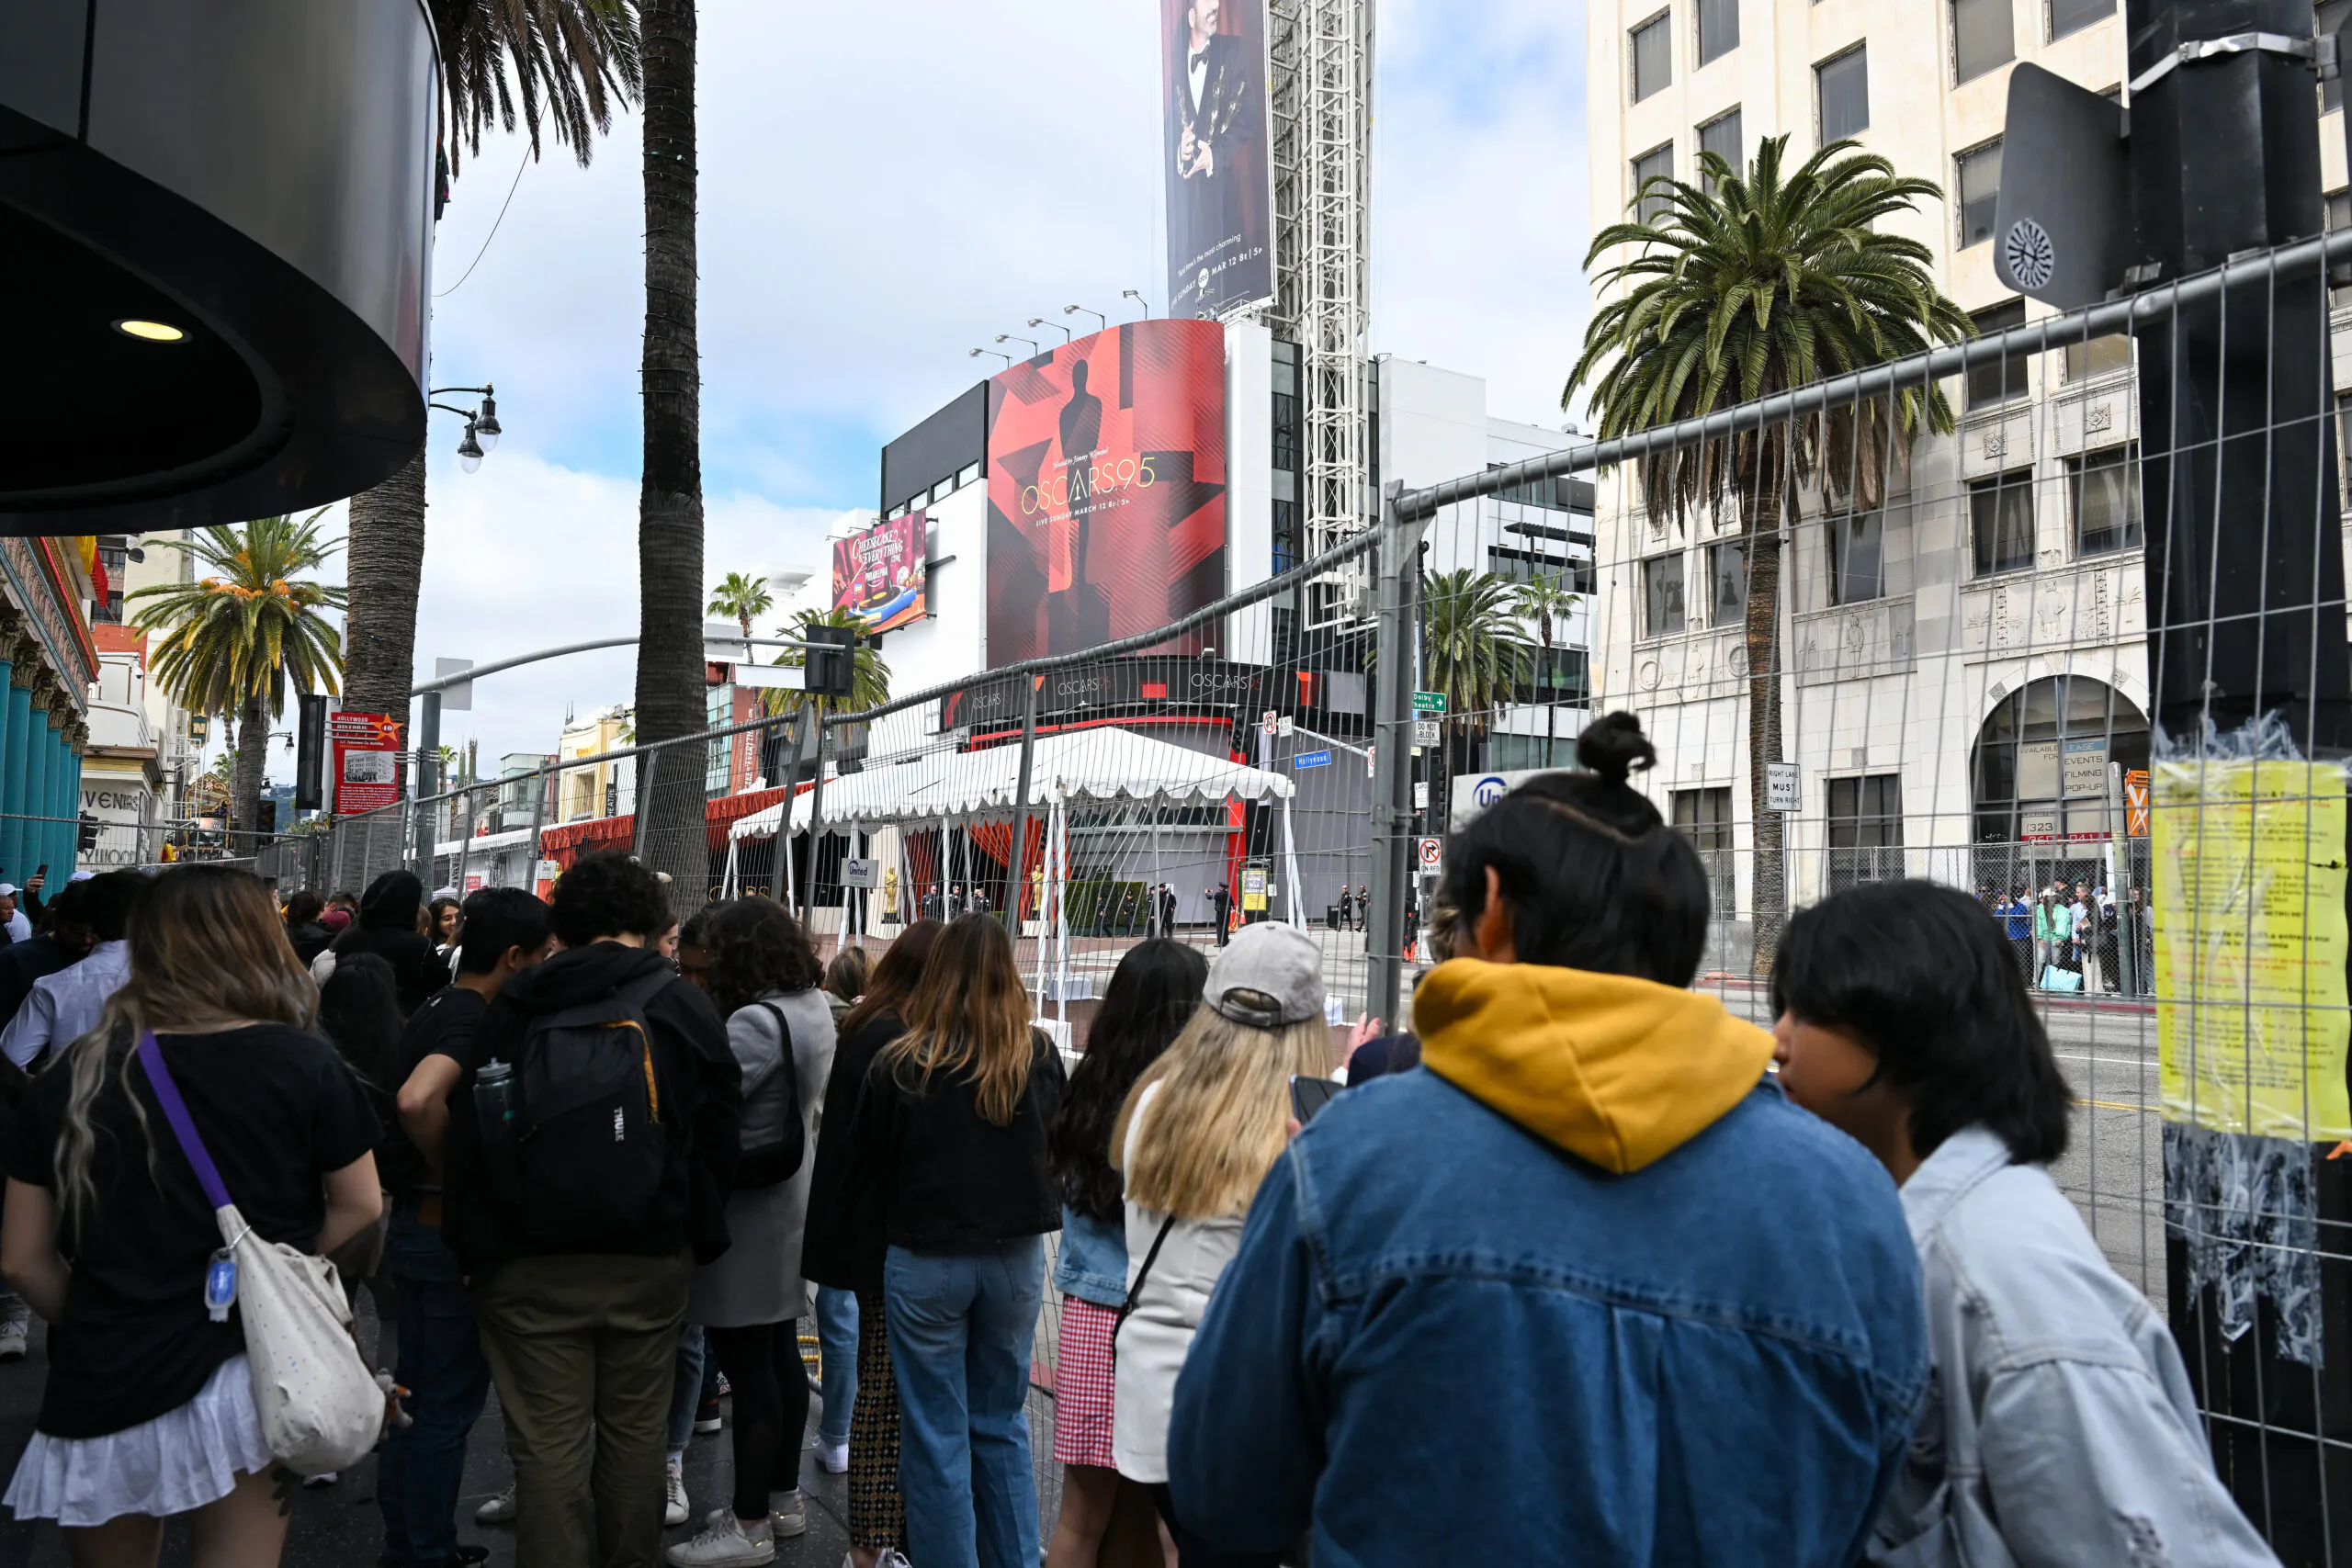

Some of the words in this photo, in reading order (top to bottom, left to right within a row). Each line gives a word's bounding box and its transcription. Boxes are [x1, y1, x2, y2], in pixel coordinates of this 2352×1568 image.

[1204, 245, 1216, 258] most
[1216, 233, 1241, 252] charming
[1177, 278, 1196, 301] SUNDAY
[1212, 262, 1227, 276] MAR
[1228, 256, 1237, 266] 12
[1035, 517, 1048, 527] LIVE
[1049, 511, 1072, 523] SUNDAY
[1074, 504, 1097, 516] MARCH
[1413, 694, 1431, 702] Dolby
[1298, 753, 1327, 765] Hollywood
[2064, 755, 2103, 765] EVENTS
[2064, 769, 2103, 778] FILMING
[1772, 783, 1795, 792] MUST
[1785, 796, 1800, 805] RIGHT
[849, 865, 868, 876] United
[614, 1106, 625, 1142] THULE
